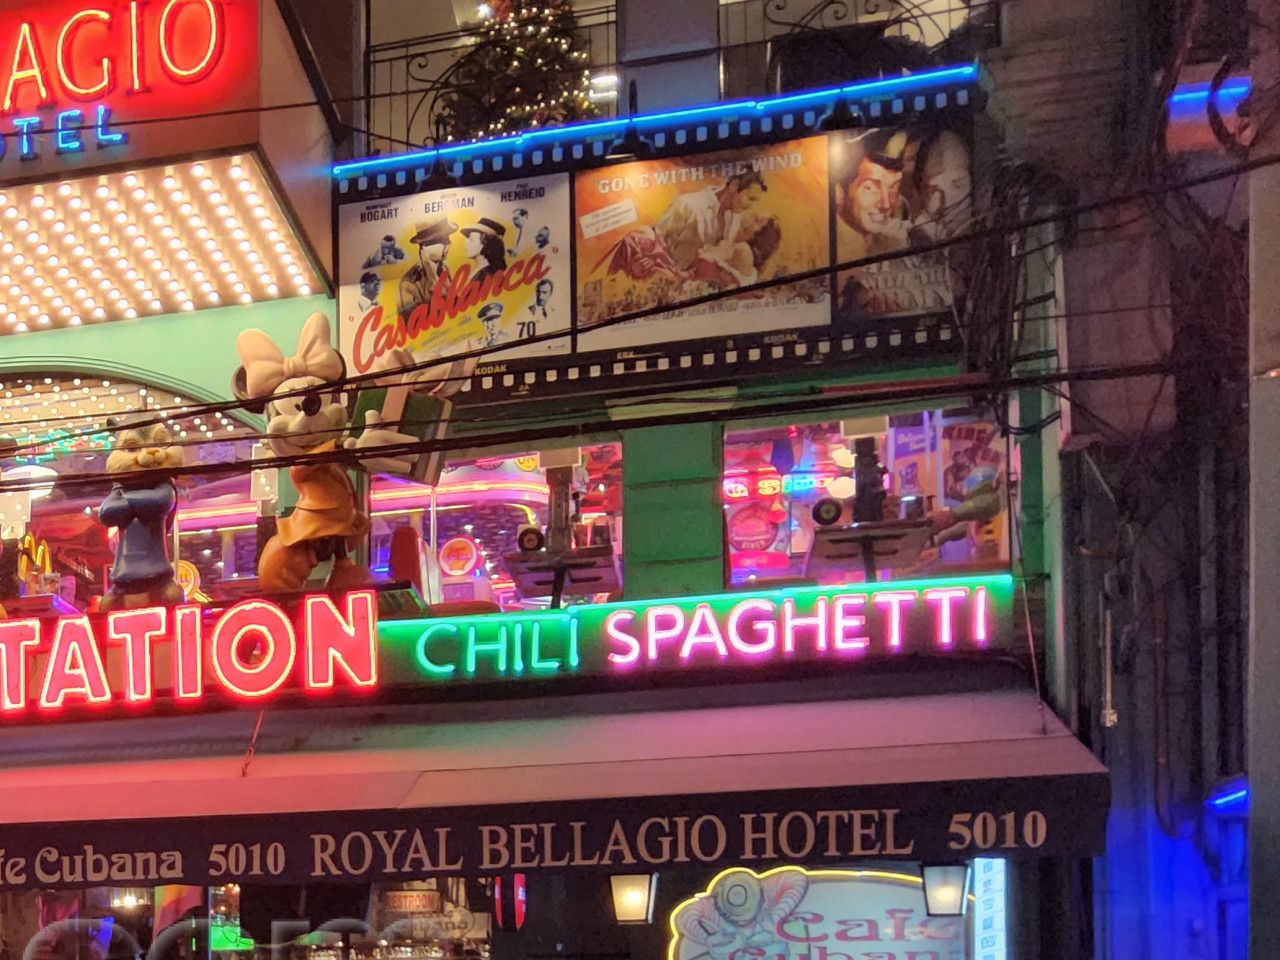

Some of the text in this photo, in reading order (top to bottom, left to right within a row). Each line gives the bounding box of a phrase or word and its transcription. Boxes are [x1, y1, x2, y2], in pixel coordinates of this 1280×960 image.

[597, 152, 804, 194] GONE WITH THE WIND
[500, 187, 546, 202] HENREID
[424, 197, 475, 213] BERAN
[360, 207, 399, 223] BOGART
[474, 364, 507, 376] KODAK
[415, 586, 989, 674] CHILI SPAGHETTI
[34, 845, 184, 884] Cubana
[208, 842, 286, 877] 5010
[310, 827, 464, 877] ROYAL
[478, 813, 727, 869] BELLAGIO
[740, 808, 915, 861] HOTEL
[947, 810, 1048, 850] 5010
